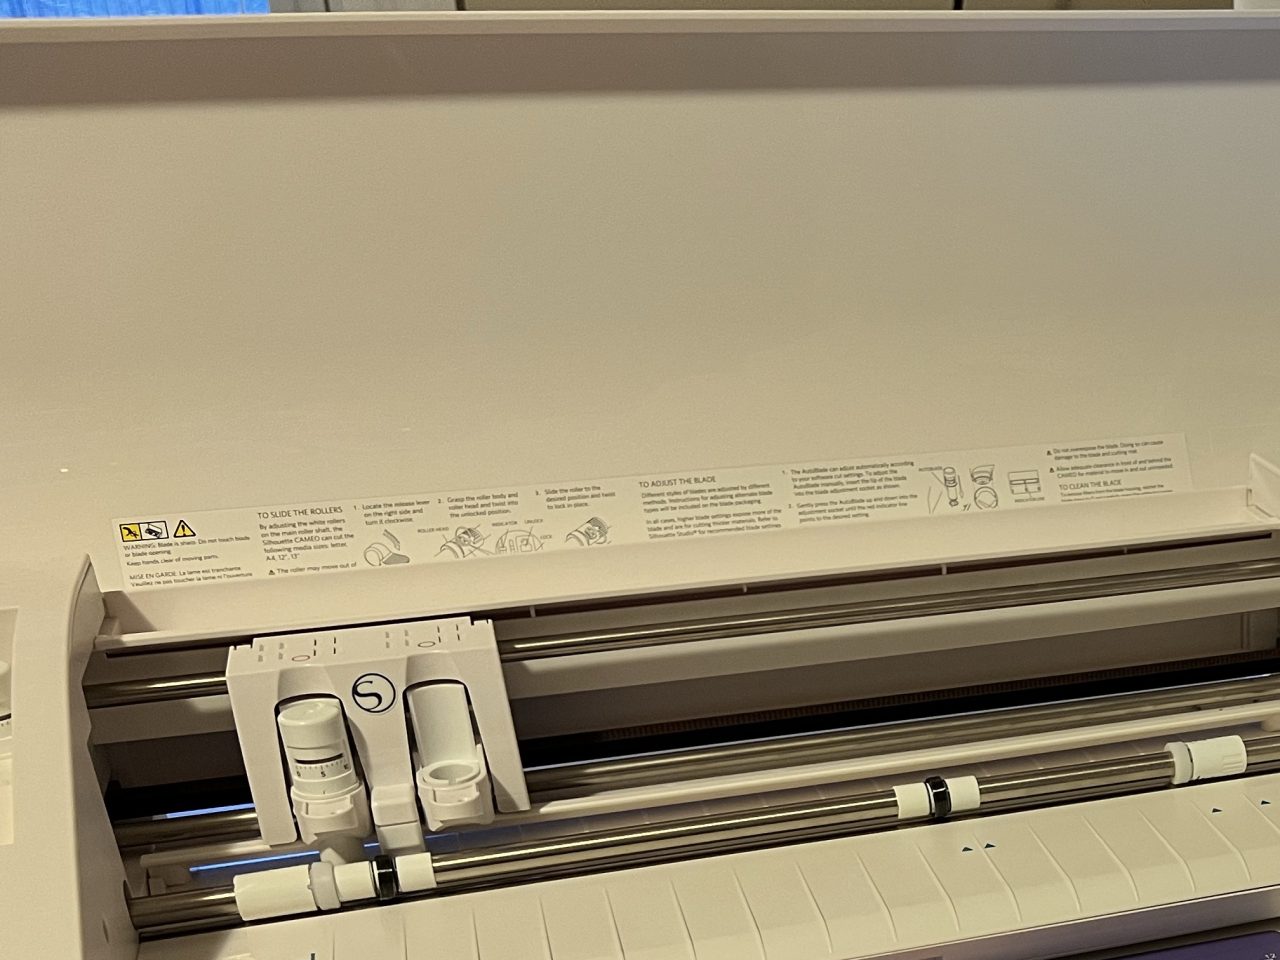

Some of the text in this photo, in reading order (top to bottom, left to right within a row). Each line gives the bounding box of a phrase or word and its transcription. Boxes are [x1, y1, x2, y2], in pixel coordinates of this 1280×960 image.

[651, 479, 677, 487] ADJUST
[678, 477, 692, 485] THE
[257, 506, 343, 520] TO SLIDE THE ROLLERS
